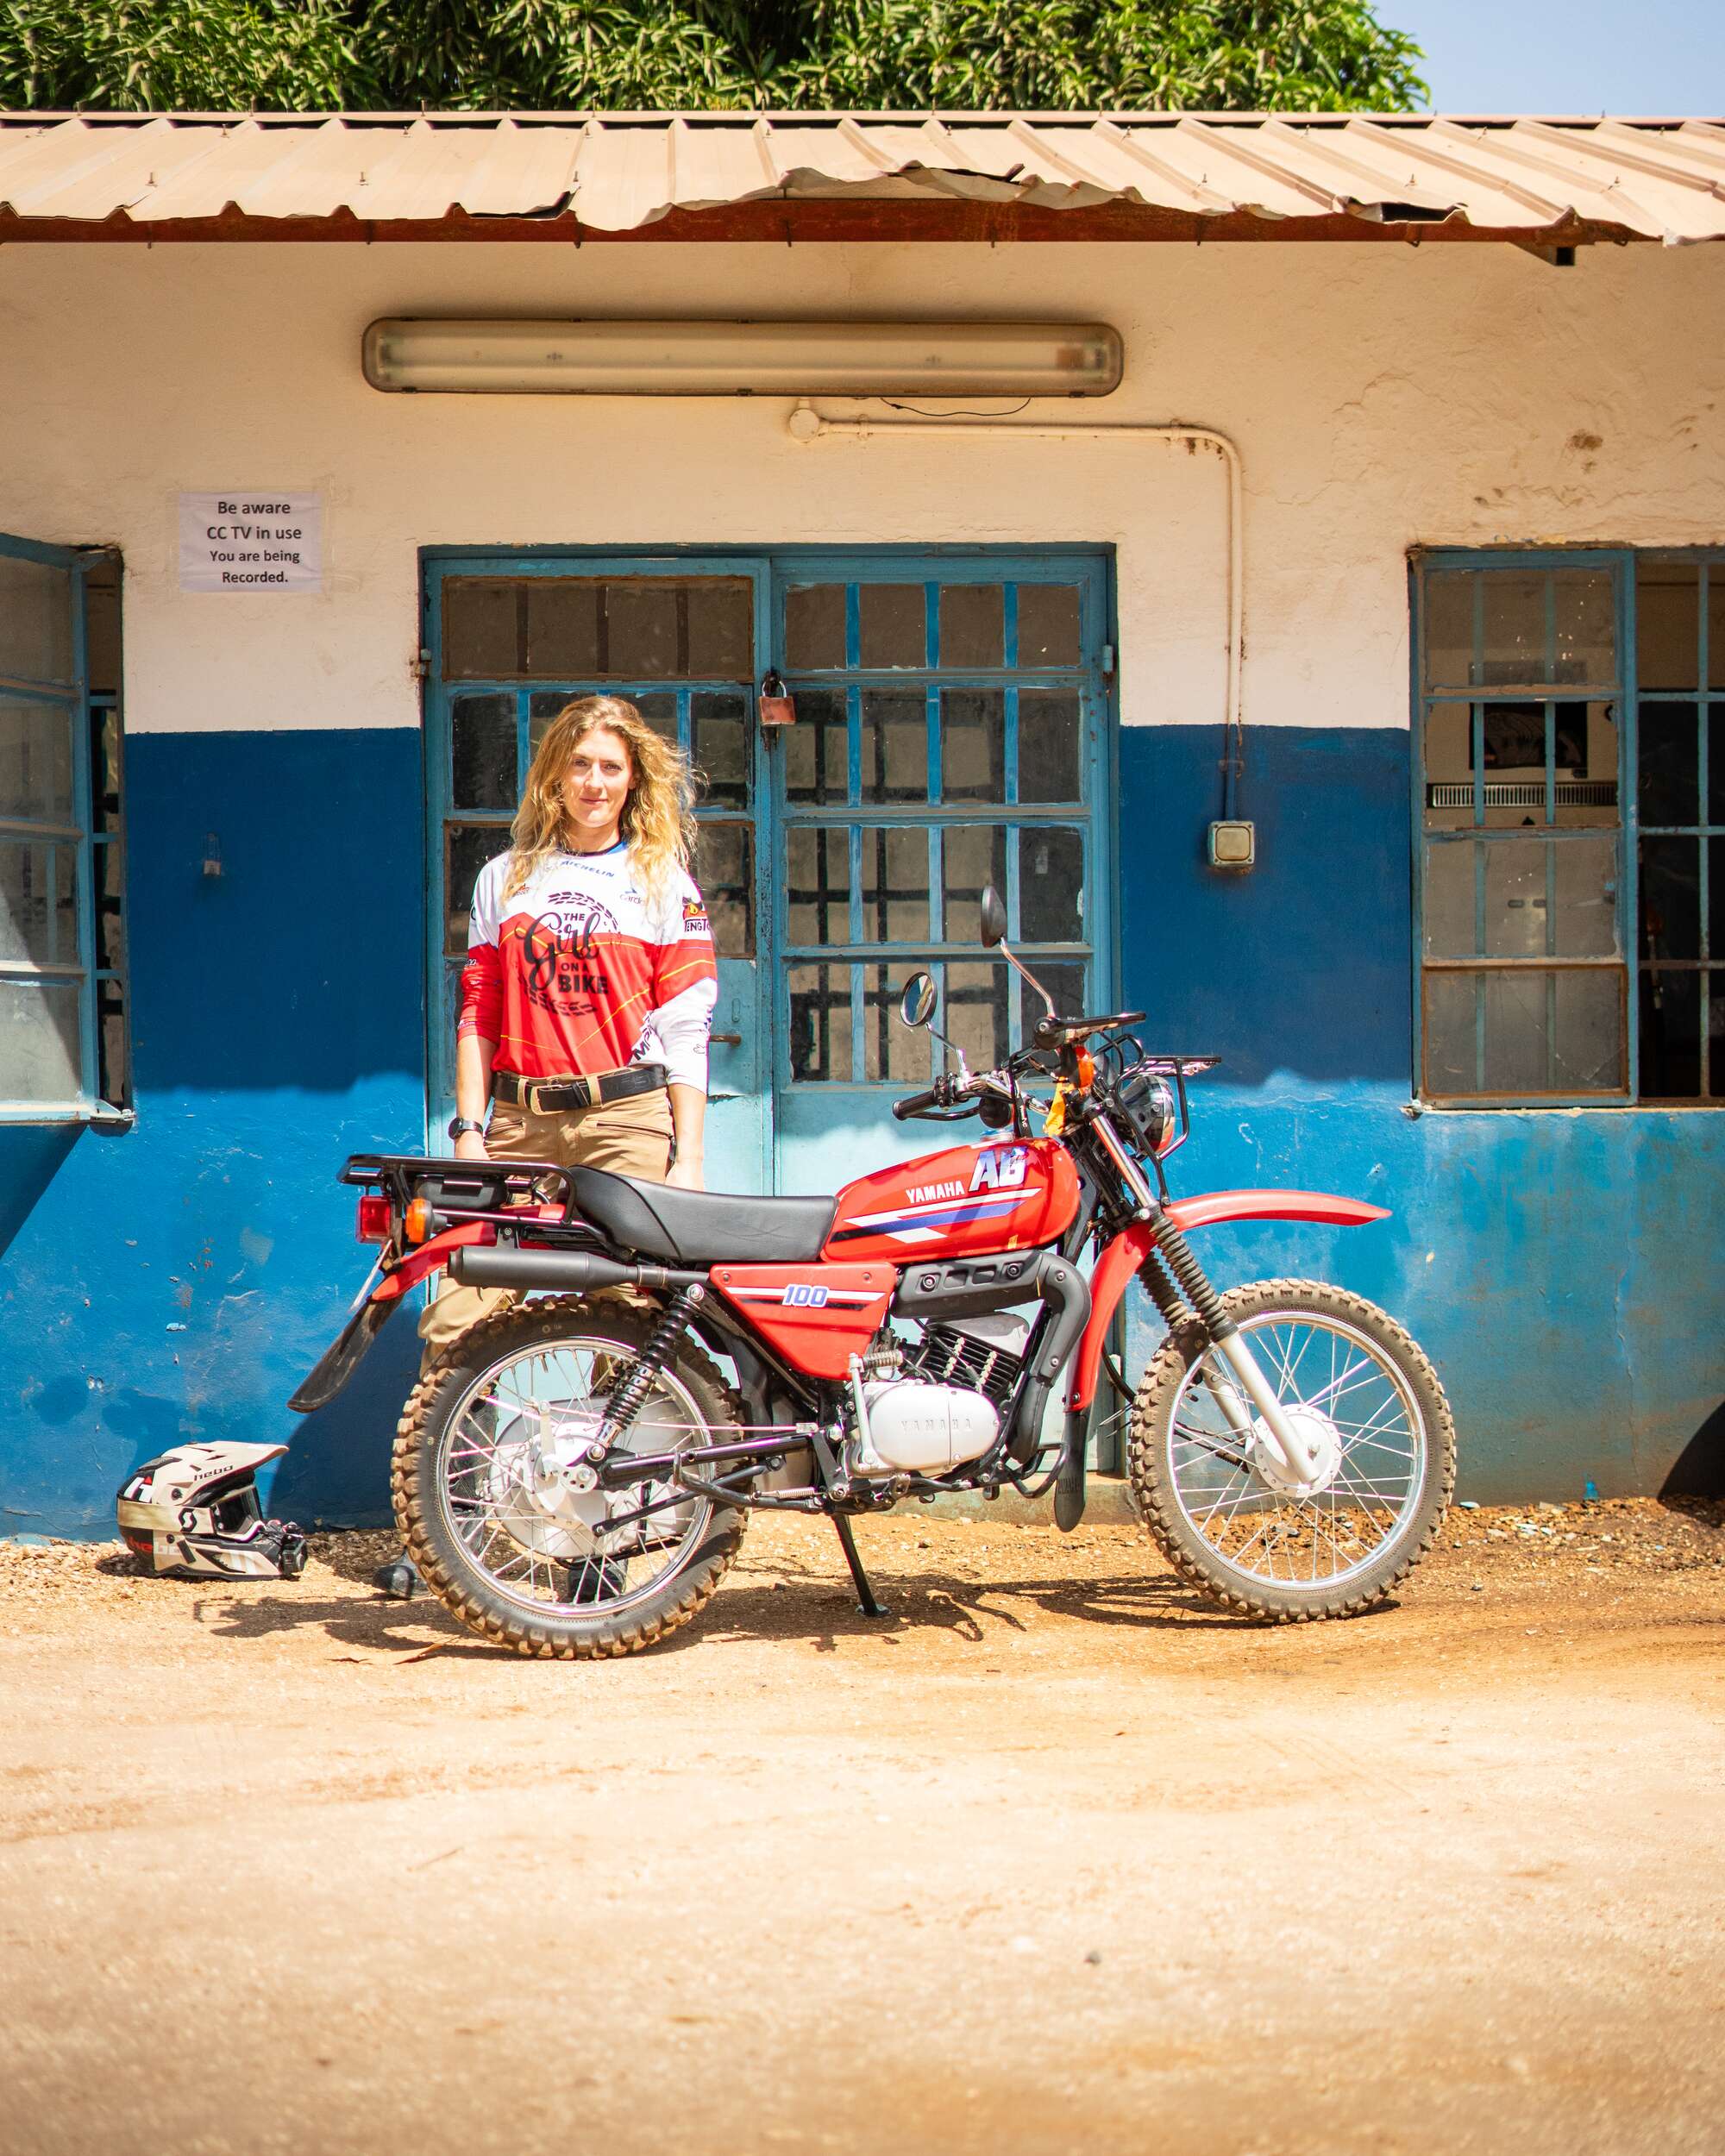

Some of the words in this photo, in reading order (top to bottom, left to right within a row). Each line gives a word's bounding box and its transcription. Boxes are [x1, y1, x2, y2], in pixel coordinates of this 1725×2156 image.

[217, 501, 237, 514] Be
[242, 503, 291, 514] aware
[207, 526, 227, 540] CC
[231, 526, 251, 539] TV
[256, 526, 270, 539] in
[275, 529, 302, 539] use
[210, 550, 235, 561] You
[238, 552, 260, 561] are
[264, 549, 300, 564] being
[222, 571, 289, 583] Recorded.
[563, 912, 585, 921] THE
[514, 912, 599, 992] Girl
[561, 962, 579, 971] ON
[582, 962, 590, 971] A
[558, 974, 609, 994] BIKE
[906, 1181, 965, 1204] YAMAHA
[783, 1284, 829, 1307] 100
[194, 1465, 233, 1481] hebo
